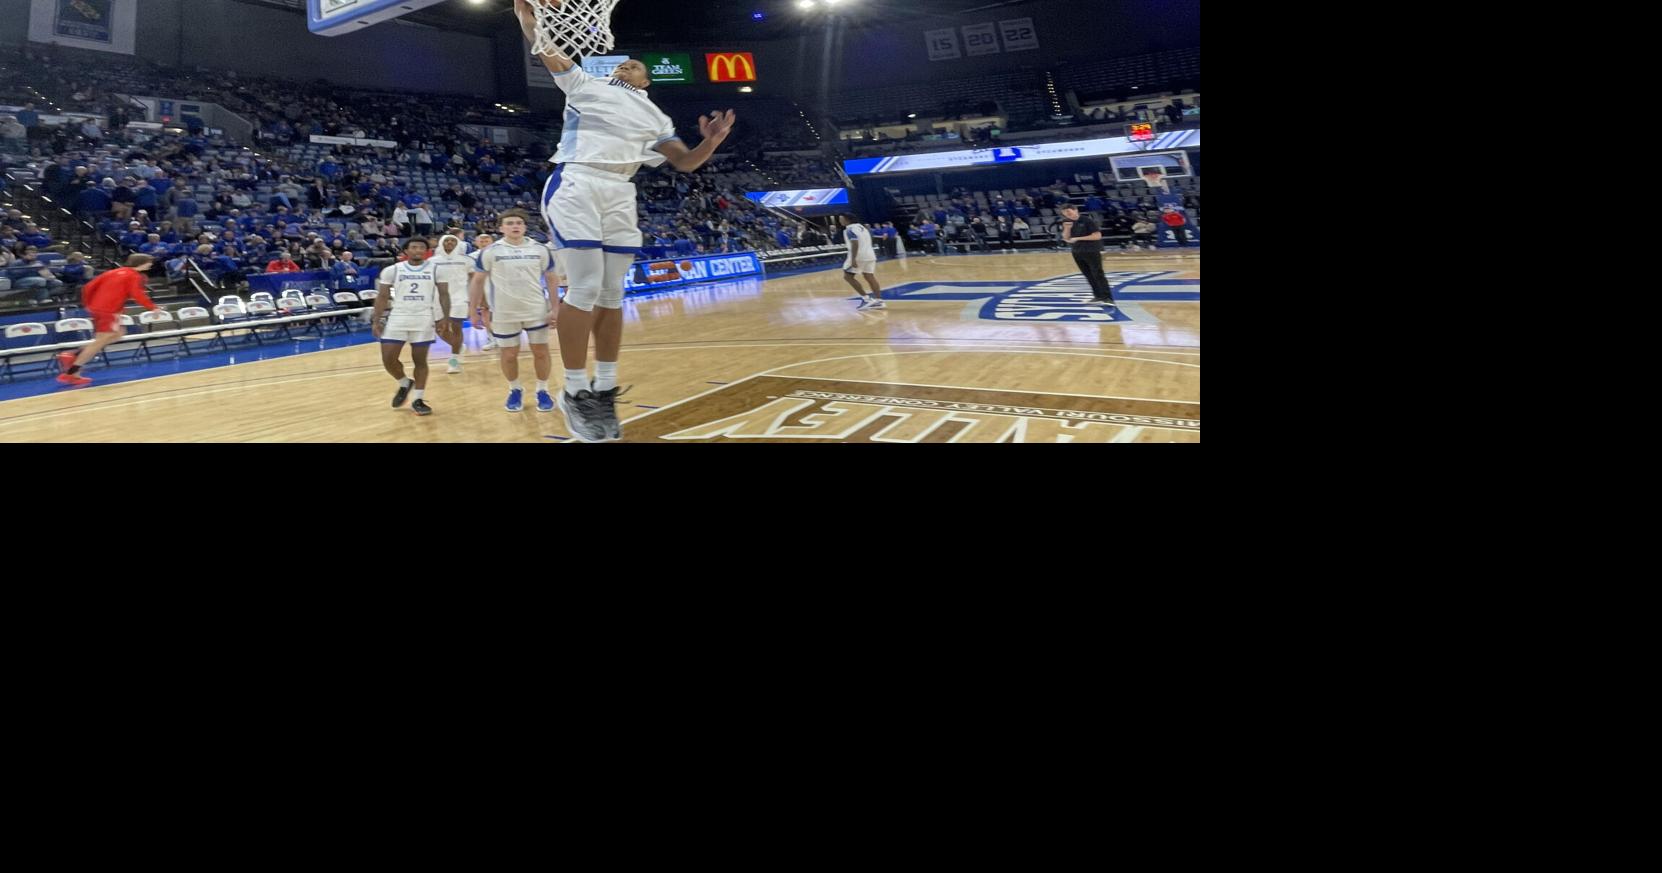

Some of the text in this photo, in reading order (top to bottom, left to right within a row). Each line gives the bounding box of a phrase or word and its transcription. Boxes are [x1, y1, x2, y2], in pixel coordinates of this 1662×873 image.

[967, 33, 994, 47] 20
[1004, 27, 1033, 41] 22
[709, 256, 755, 276] CENTER
[410, 282, 419, 293] 2
[948, 403, 1044, 415] VALLEY
